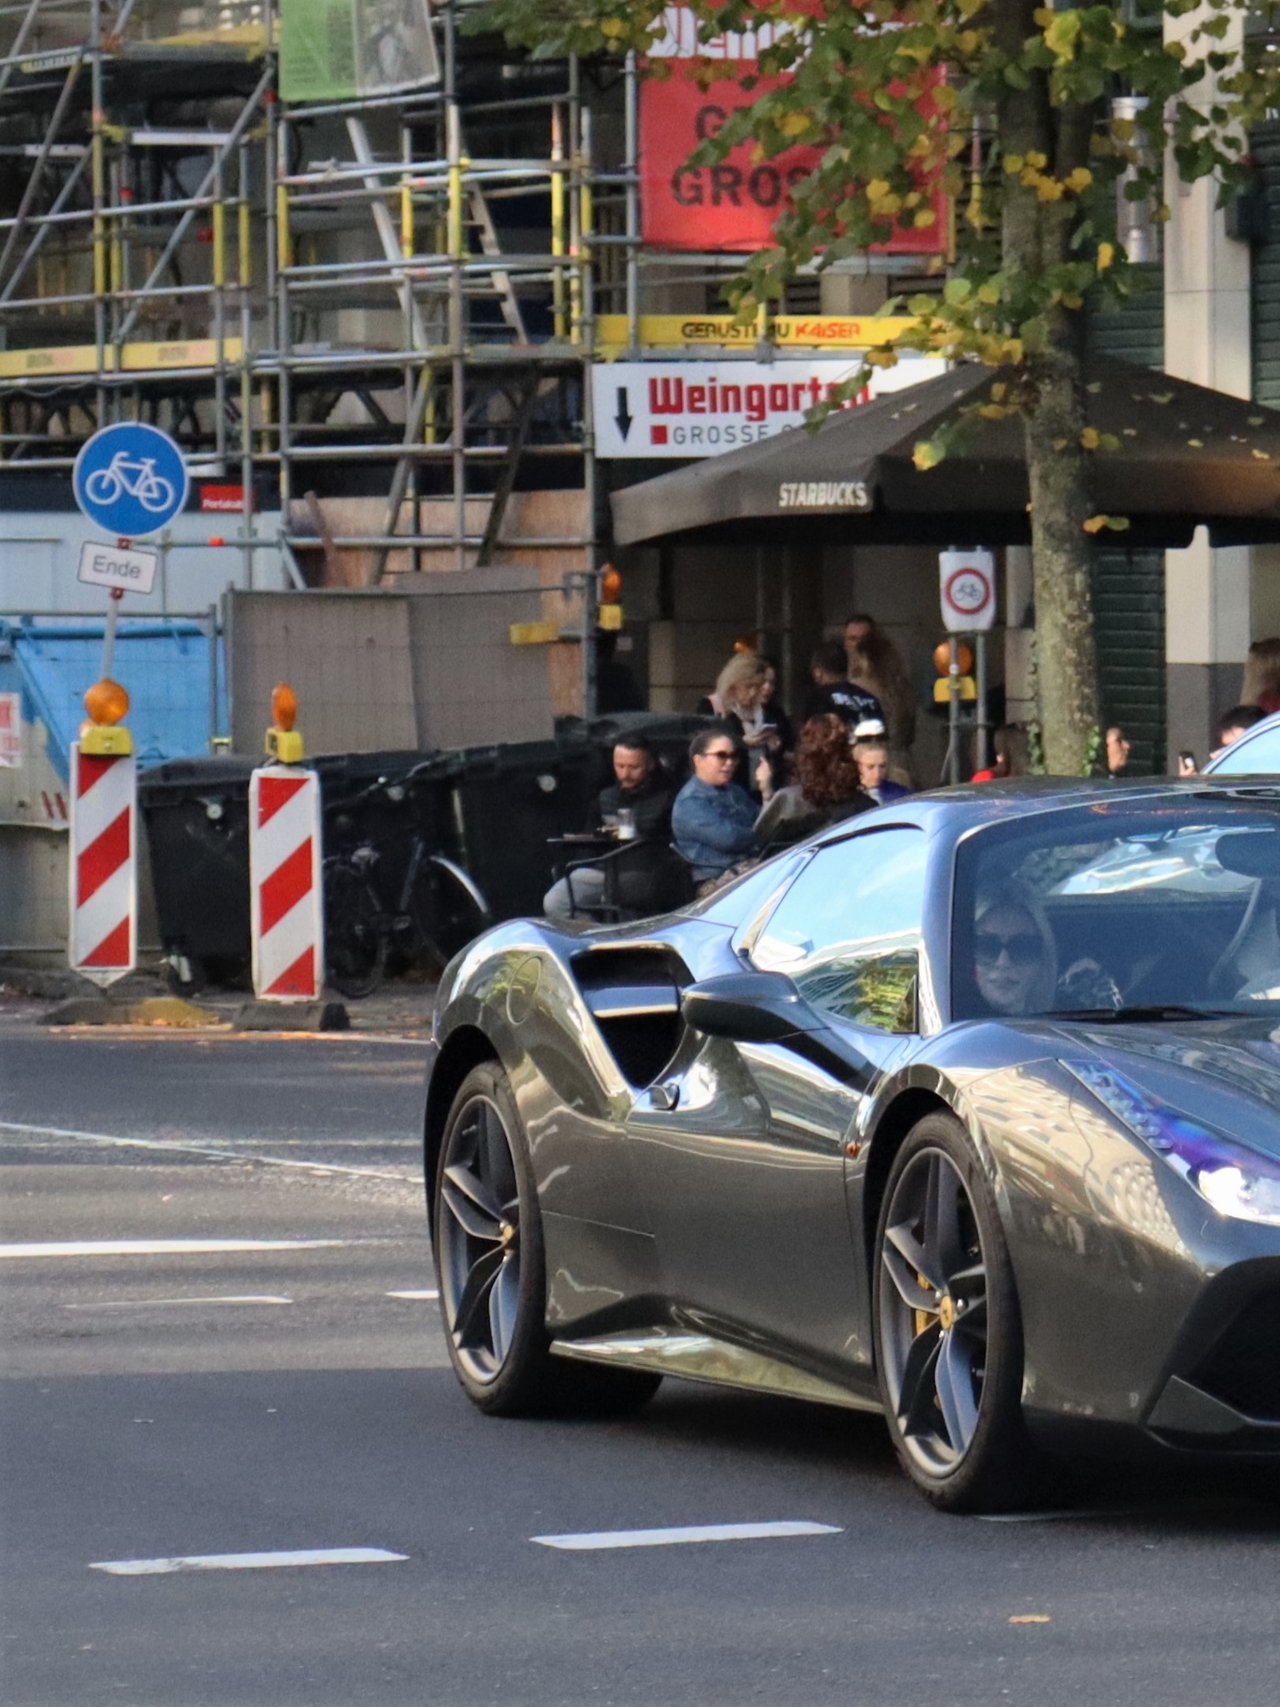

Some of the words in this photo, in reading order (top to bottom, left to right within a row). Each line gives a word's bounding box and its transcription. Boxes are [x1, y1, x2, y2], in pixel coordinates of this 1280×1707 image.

[648, 376, 870, 422] Weingart
[779, 482, 867, 507] STARBUCKS
[92, 554, 141, 579] Ende
